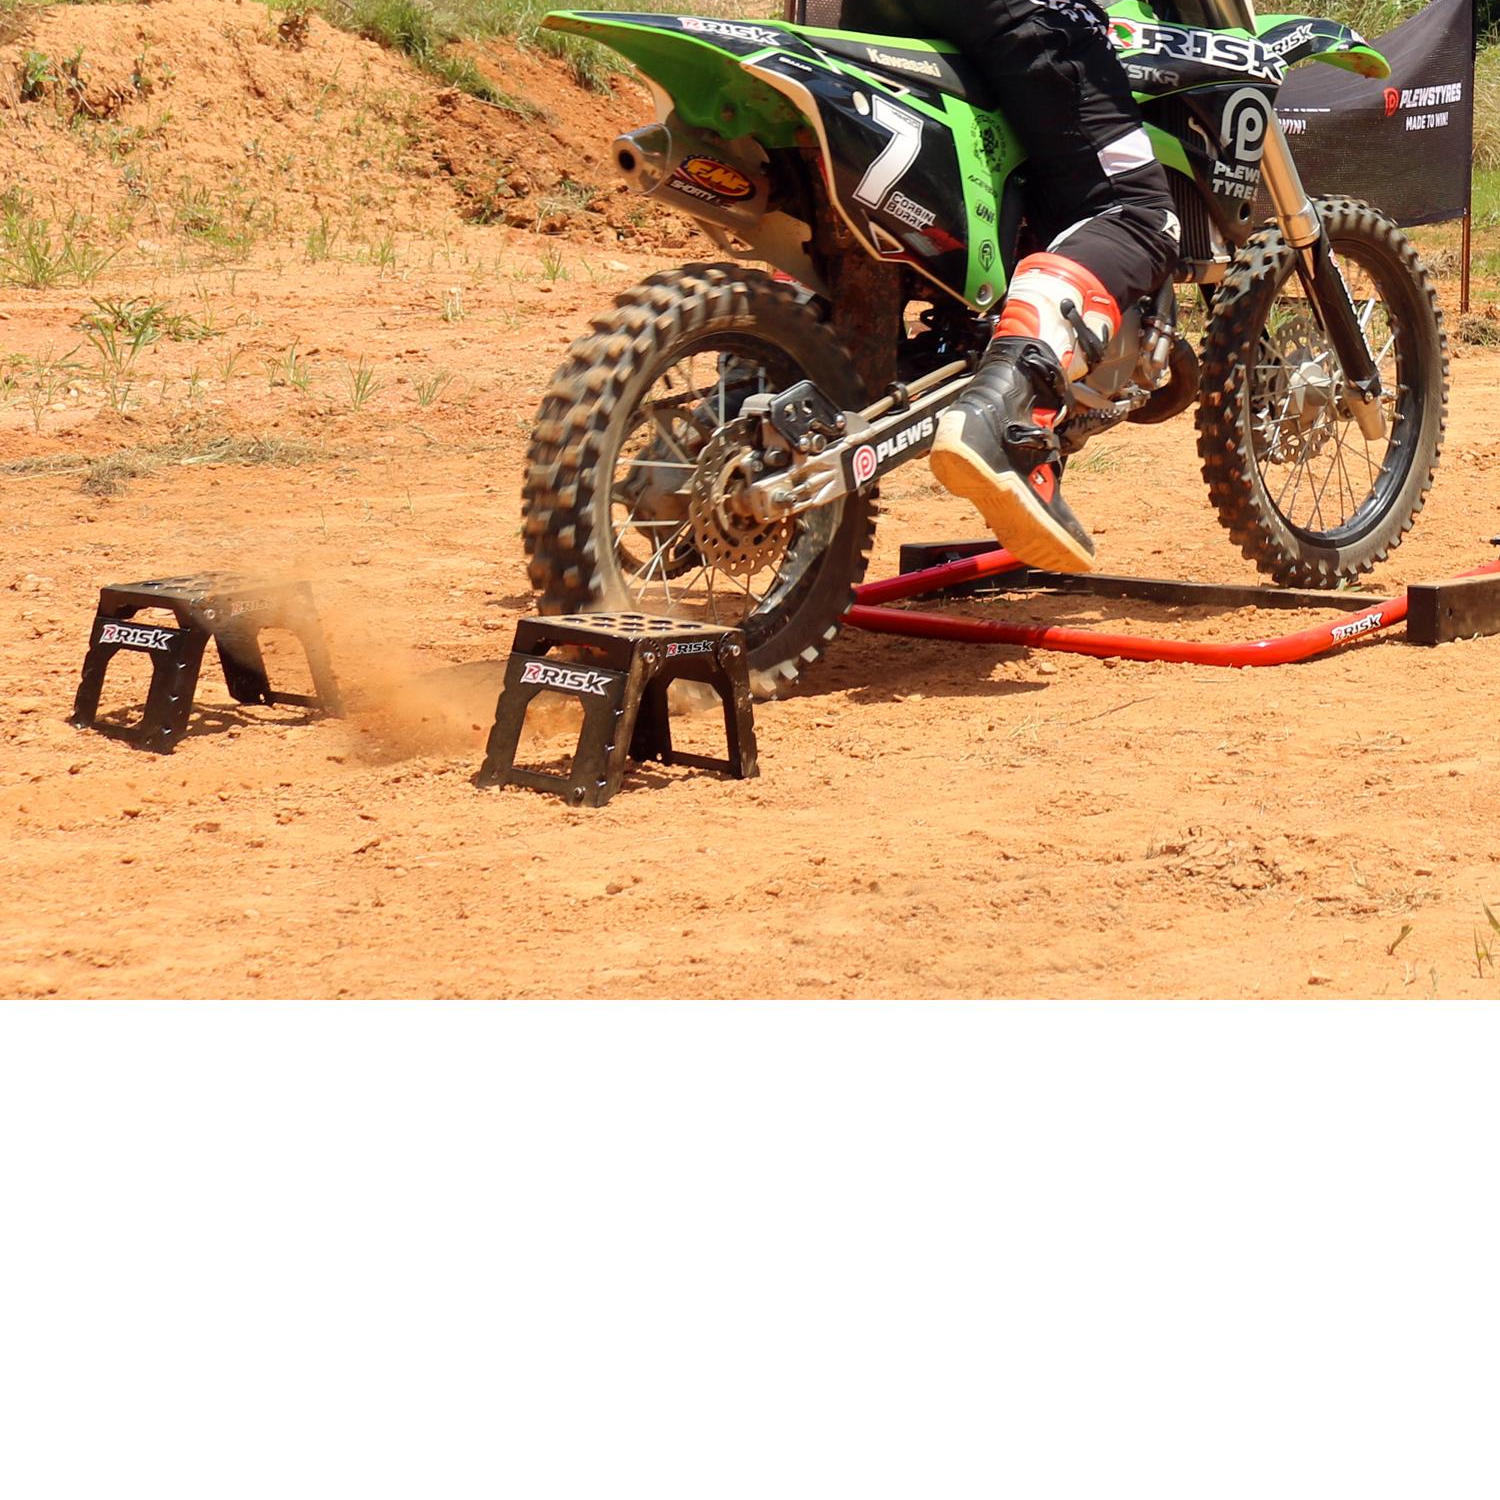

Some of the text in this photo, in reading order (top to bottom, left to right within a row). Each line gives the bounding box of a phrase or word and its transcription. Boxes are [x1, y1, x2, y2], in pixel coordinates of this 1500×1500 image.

[697, 21, 781, 47] RISK
[1271, 22, 1314, 55] RISK
[865, 47, 943, 78] Kawasaki
[1139, 22, 1288, 86] RISK
[1399, 82, 1462, 109] PLEWSTYRES
[1406, 115, 1426, 131] MADE
[1426, 114, 1435, 129] TO
[852, 94, 924, 210] 7
[687, 160, 750, 190] FMF
[670, 180, 717, 201] SHORTY
[883, 201, 929, 232] BURRY
[889, 190, 937, 227] CORBIN
[876, 416, 934, 463] PLEWS
[114, 628, 174, 651] RISK
[1341, 612, 1383, 638] RISK
[675, 640, 715, 655] RISK
[538, 667, 614, 696] RISK
